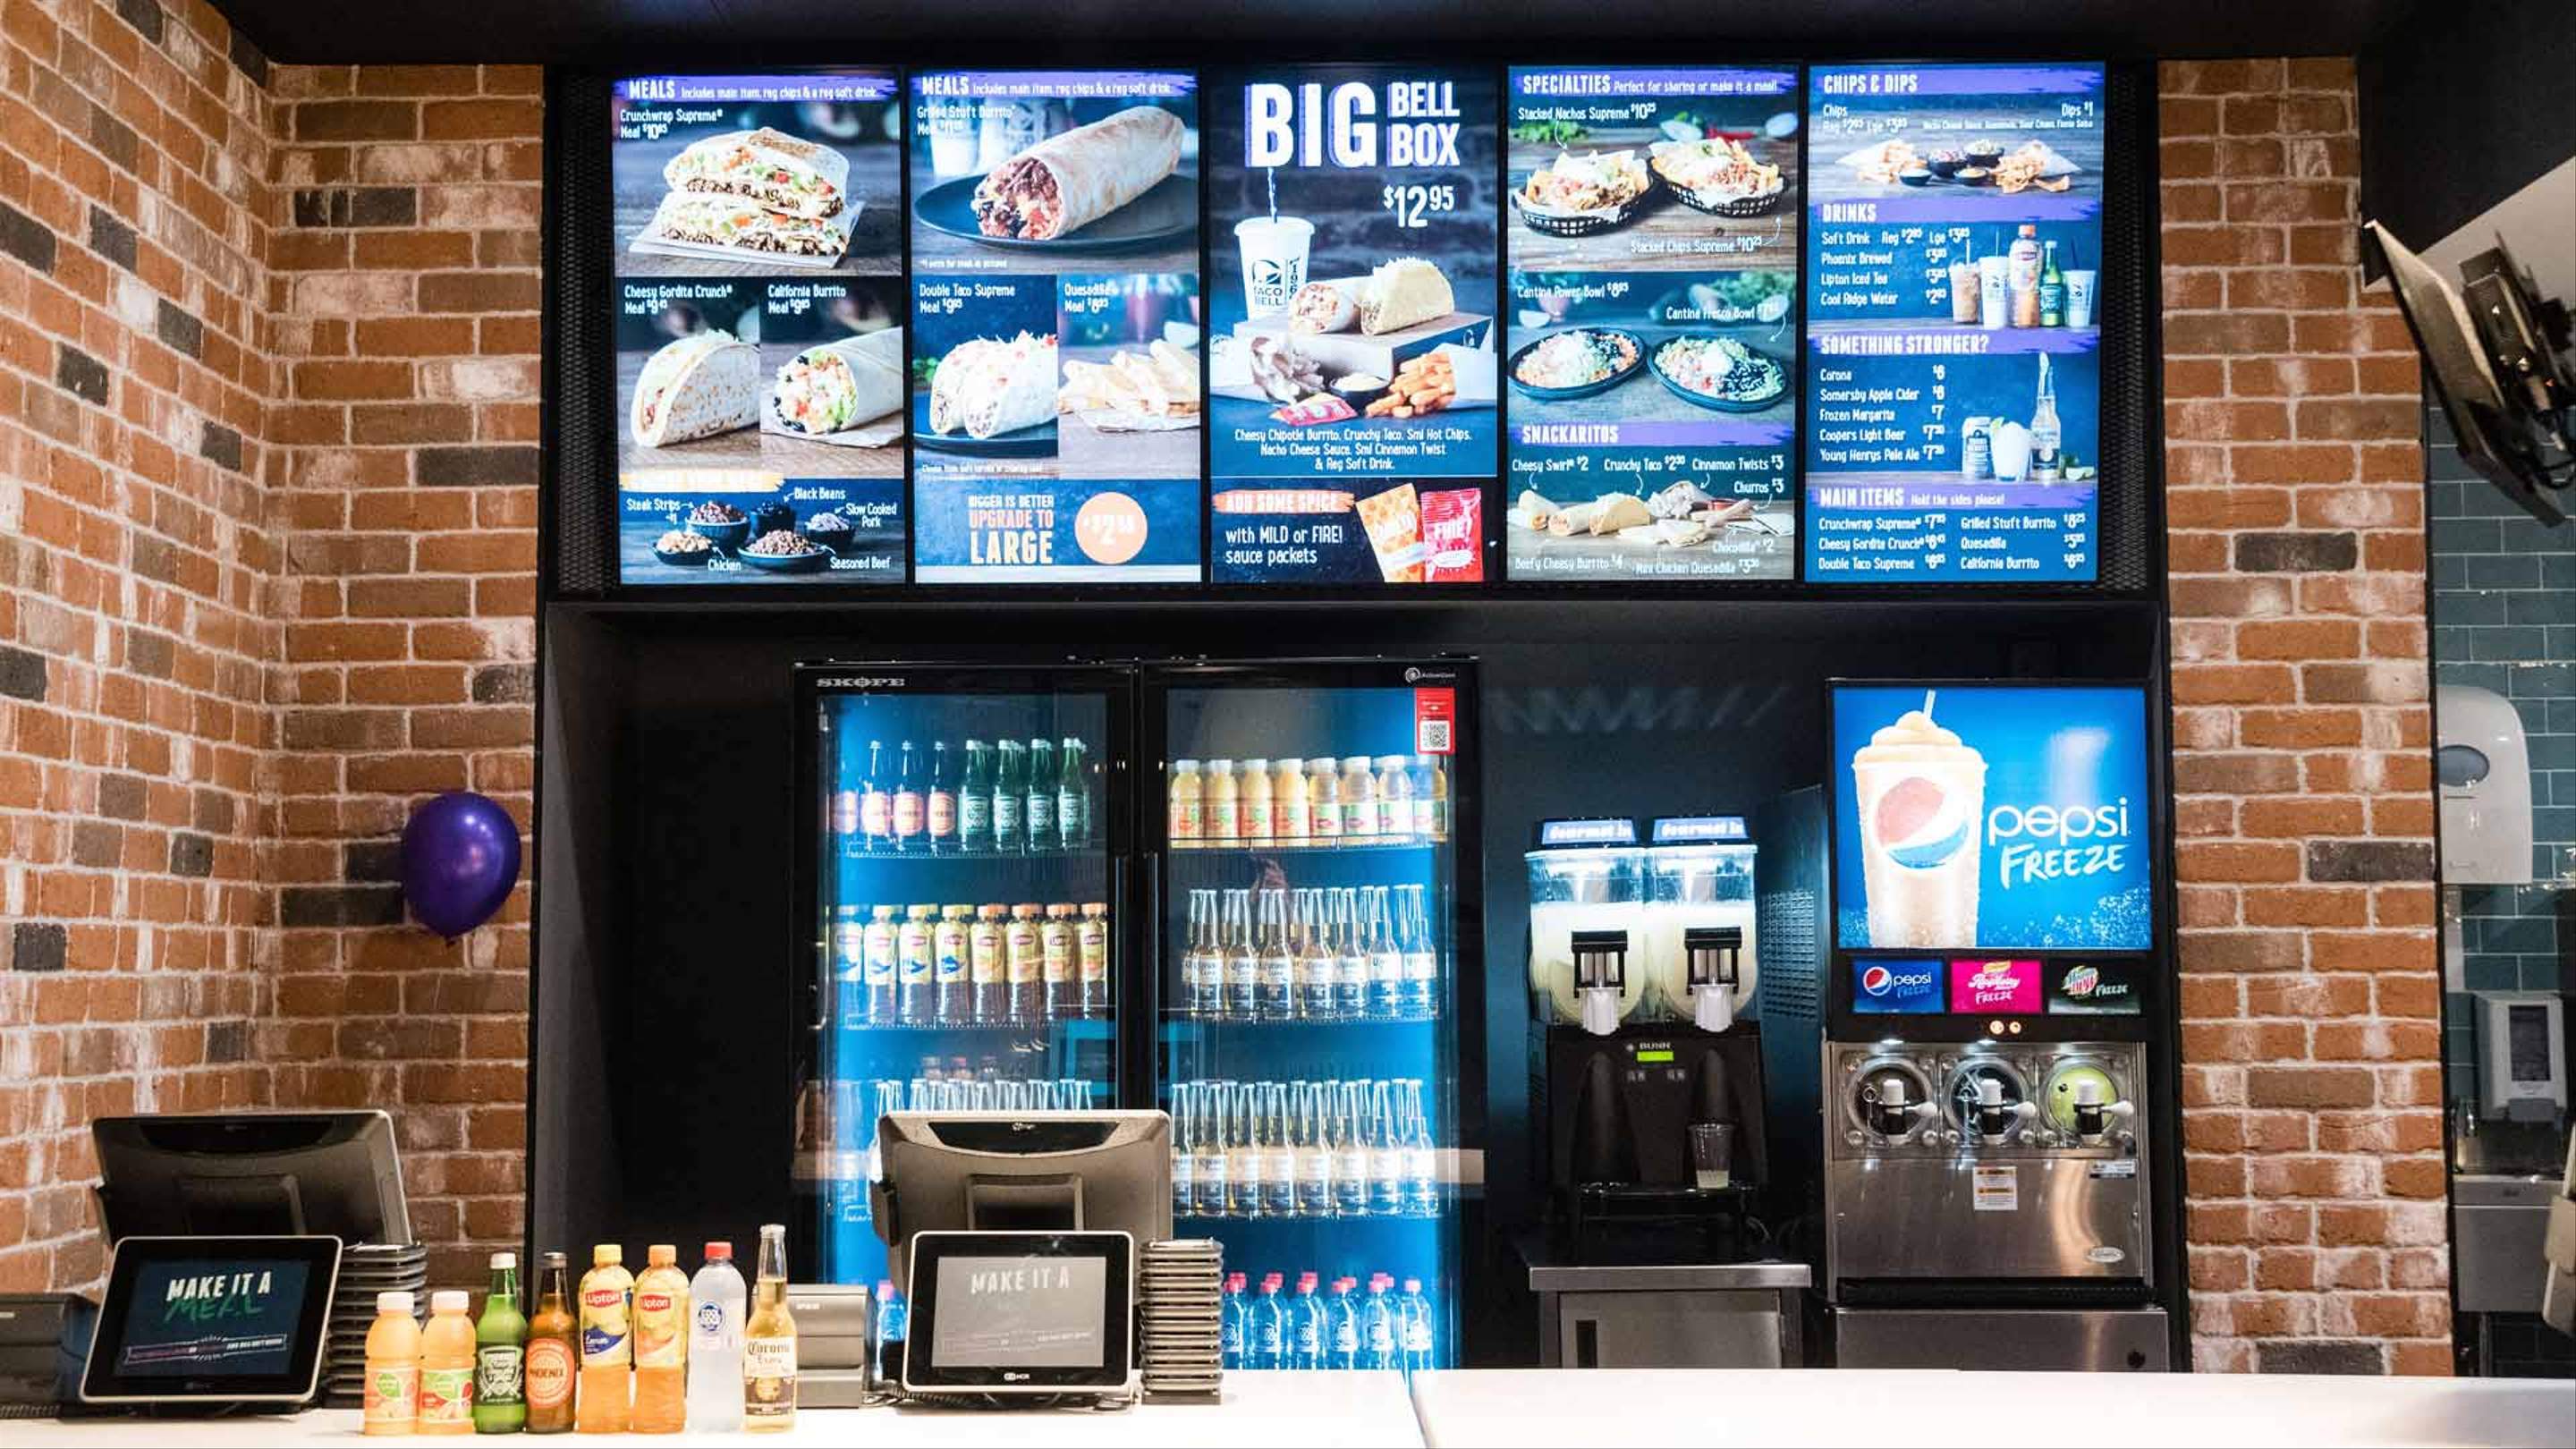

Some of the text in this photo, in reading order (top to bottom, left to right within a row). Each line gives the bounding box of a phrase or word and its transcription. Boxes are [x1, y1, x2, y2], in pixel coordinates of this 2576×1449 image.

[630, 80, 675, 98] MEALS
[921, 76, 969, 95] MEALS
[1523, 75, 1610, 94] SPECIALTIES
[1614, 80, 1645, 93] Perfect
[1647, 80, 1661, 93] for
[1664, 80, 1695, 95] sharing
[1698, 84, 1708, 93] or
[1710, 80, 1733, 92] make
[1735, 80, 1743, 92] it
[1825, 75, 1918, 94] CHIPS & DIPS
[1387, 81, 1460, 117] BELL
[620, 109, 673, 123] Crunchwrap
[1518, 106, 1629, 121] Stacked Nachos Supreme
[1823, 104, 1848, 117] Chips
[2062, 103, 2081, 117] Dips
[1245, 82, 1377, 168] BIG
[620, 126, 640, 139] Meal
[1386, 123, 1460, 166] BOX
[1822, 204, 1877, 223] DRINKS
[1821, 232, 1899, 246] Soft Drink Reg
[1860, 252, 1892, 265] Brewed
[1821, 272, 1888, 286] Lipton Iced Tea
[625, 284, 692, 299] Cheesy Gordita
[767, 284, 810, 298] California
[919, 284, 1015, 298] Double Taco Supreme
[1518, 285, 1551, 298] Cantina
[1584, 284, 1605, 298] Bowl
[1820, 292, 1898, 307] Cool Ridge Water
[625, 301, 645, 314] Meal
[768, 301, 789, 314] Meal
[919, 301, 940, 313] Meal
[1064, 301, 1084, 313] Meal
[1666, 306, 1700, 319] Cantina
[1733, 306, 1755, 319] Bowl
[1821, 335, 1989, 354] SOMETHING STRONGER?
[1820, 369, 1852, 382] Corona
[1820, 389, 1919, 403] Somersby Apple Cider
[1819, 409, 1895, 423] Frozen Margarita
[1234, 429, 1303, 442] Cheesy Chipotle
[1344, 429, 1381, 442] Crunchy
[1407, 429, 1443, 440] Sml Hot
[1521, 425, 1619, 445] SNACKARITOS
[1819, 428, 1905, 444] Coopers Light Beer
[1261, 444, 1321, 456] Nacho Cheese
[1355, 444, 1417, 455] Sml Cinnamon
[1820, 449, 1919, 464] Young Henrys Pale Ale
[1315, 459, 1323, 470] &
[1326, 459, 1343, 472] Reg
[1346, 459, 1367, 470] Soft
[1513, 459, 1543, 472] Cheesy
[1577, 455, 1662, 472] $2 Crunchy Taco
[1692, 454, 1784, 470] Cinnamon Twists $3
[794, 487, 845, 500] Black Beans
[1734, 479, 1784, 495] Churros $3
[1005, 496, 1054, 508] IS BETTER
[1226, 493, 1338, 513] ADD SOME SPICE
[1820, 488, 1903, 507] MAIN ITEMS
[626, 498, 681, 513] Steak Strips
[846, 503, 896, 516] Slow Cooked
[861, 515, 881, 528] Pork
[969, 510, 1054, 528] UPGRADE TO
[1818, 518, 1872, 532] Crunchwrap
[1961, 518, 2056, 530] Grilled Stuft Burrito
[1226, 526, 1343, 544] with MILD or FIRE!
[970, 531, 1053, 564] LARGE
[1818, 538, 1885, 553] Cheesy Gordita
[1961, 538, 2006, 551] Quesadilla
[830, 556, 891, 570] Seasoned Beef
[1226, 548, 1318, 564] sauce packets
[708, 559, 741, 572] Chicken
[1818, 559, 1914, 572] Double Taco Supreme
[1961, 558, 2039, 570] California Burrito
[817, 676, 905, 689] SKOPE
[1988, 798, 2131, 847] pepsi
[2000, 843, 2130, 890] FREEZE
[1894, 971, 1931, 987] pepsi
[1975, 991, 2013, 1004] FREEZE
[1640, 1042, 1671, 1050] BUNN
[166, 1272, 271, 1301] MAKE IT A
[970, 1266, 1070, 1295] MAKE IT A
[588, 1292, 622, 1305] Lipton
[748, 1341, 790, 1354] Corona
